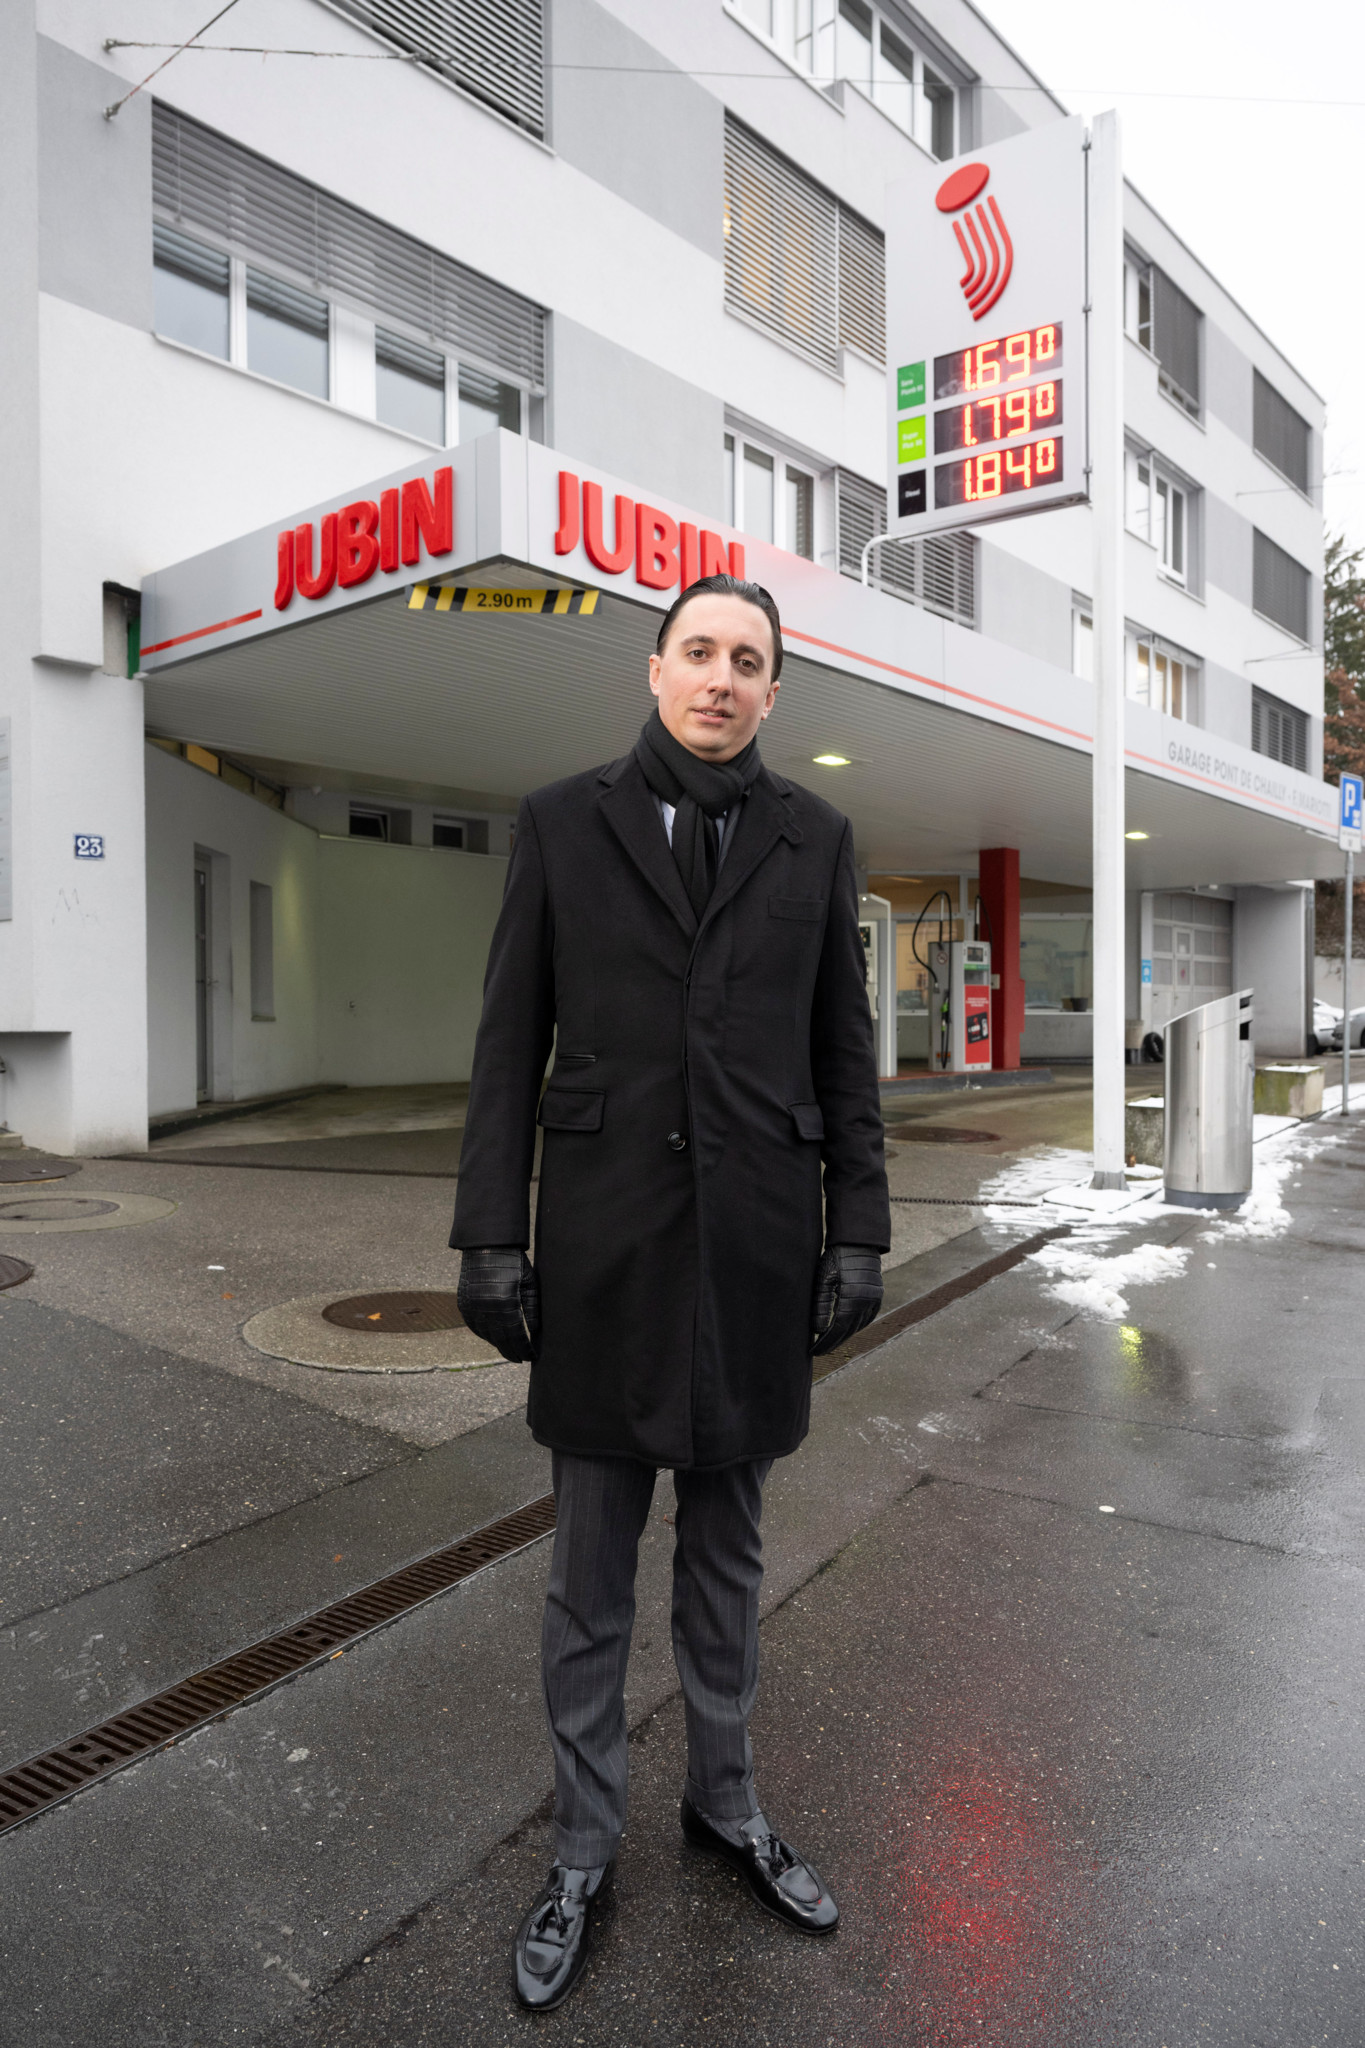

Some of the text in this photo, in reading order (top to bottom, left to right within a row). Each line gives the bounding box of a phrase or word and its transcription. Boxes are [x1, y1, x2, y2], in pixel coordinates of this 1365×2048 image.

[274, 466, 453, 611] JUBIN
[554, 470, 745, 596] JUBIN
[1168, 741, 1211, 774] GARAGE
[1214, 758, 1239, 784] PONT
[1240, 768, 1251, 789] DE
[1254, 774, 1286, 800] CHAILLY
[1345, 782, 1356, 818] P
[77, 837, 101, 857] 23
